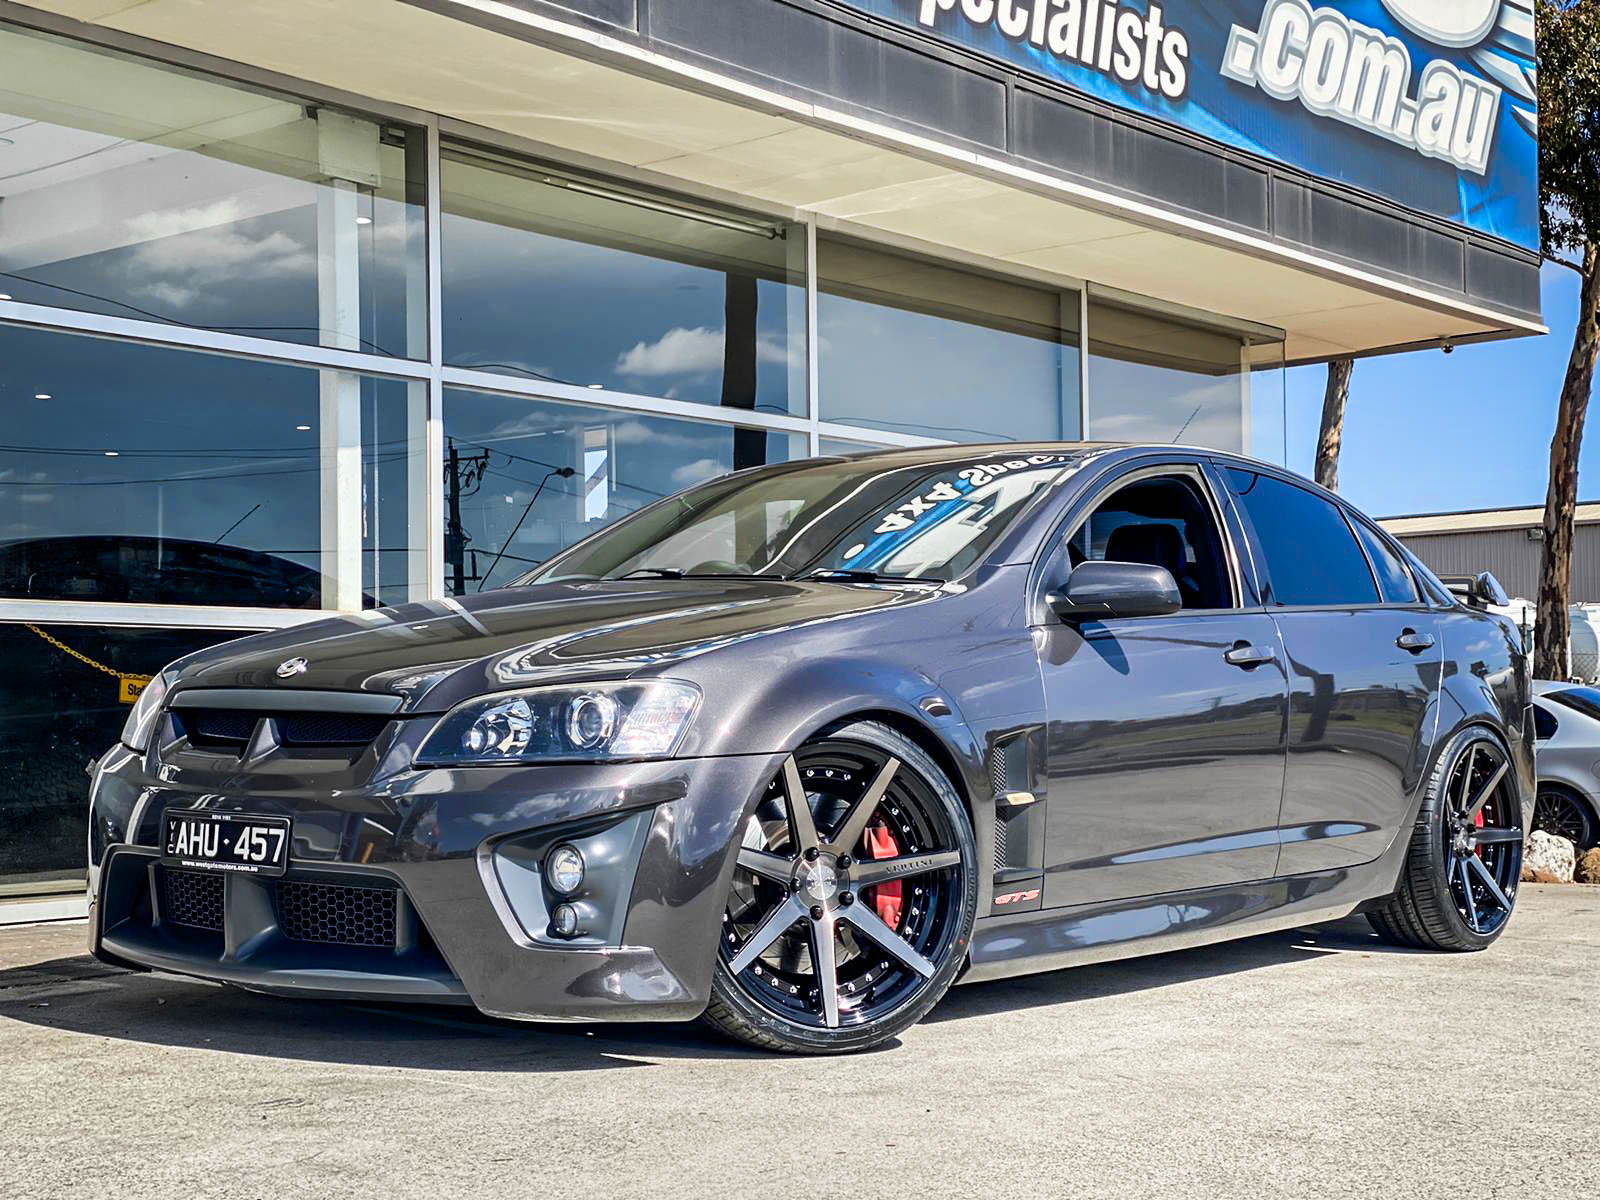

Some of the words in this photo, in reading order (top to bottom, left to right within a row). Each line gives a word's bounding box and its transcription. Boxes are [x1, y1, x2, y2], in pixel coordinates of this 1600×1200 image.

[1230, 2, 1497, 167] .com.au
[167, 821, 177, 854] VIC
[175, 821, 220, 858] AHU
[233, 826, 286, 863] 457
[994, 888, 1041, 905] GTS
